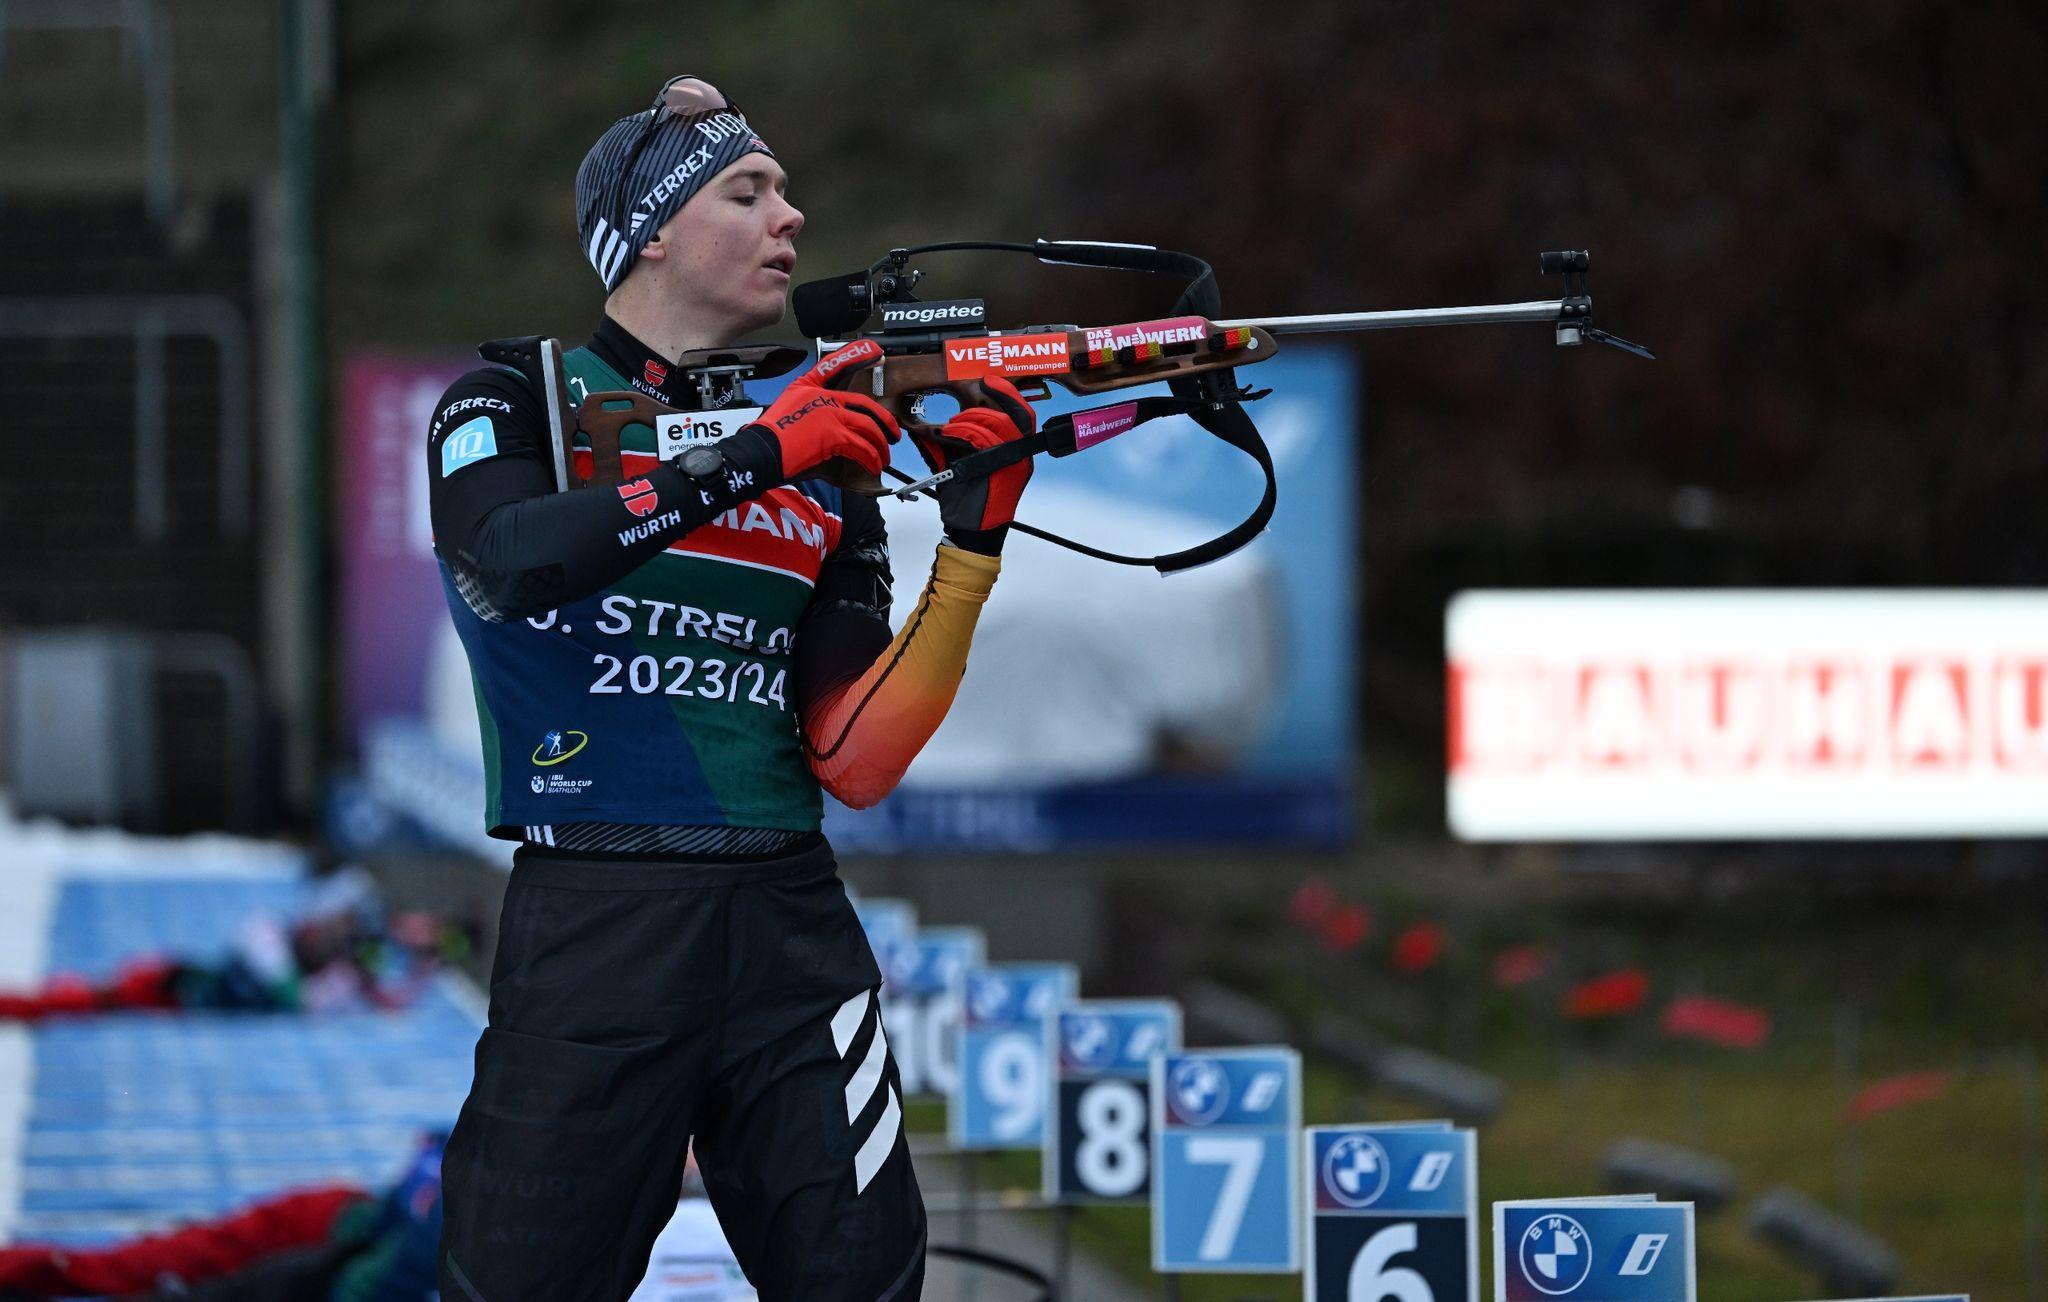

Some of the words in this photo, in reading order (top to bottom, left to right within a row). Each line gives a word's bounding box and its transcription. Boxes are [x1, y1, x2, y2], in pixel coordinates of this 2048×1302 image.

[641, 145, 714, 213] TERREX
[884, 305, 984, 323] mogatec
[1086, 329, 1113, 341] DAS
[950, 340, 1068, 368] VIESSMANN
[1005, 361, 1068, 374] Wärmepumpen
[667, 416, 724, 441] eins
[1077, 422, 1092, 430] DAS
[618, 509, 682, 548] WÜRTH
[589, 653, 788, 712] 2023/24
[980, 1031, 1042, 1140] 9
[1074, 1077, 1148, 1197] 8
[1185, 1136, 1264, 1262] 7
[1528, 1217, 1583, 1242] BMW
[1347, 1221, 1436, 1302] 6
